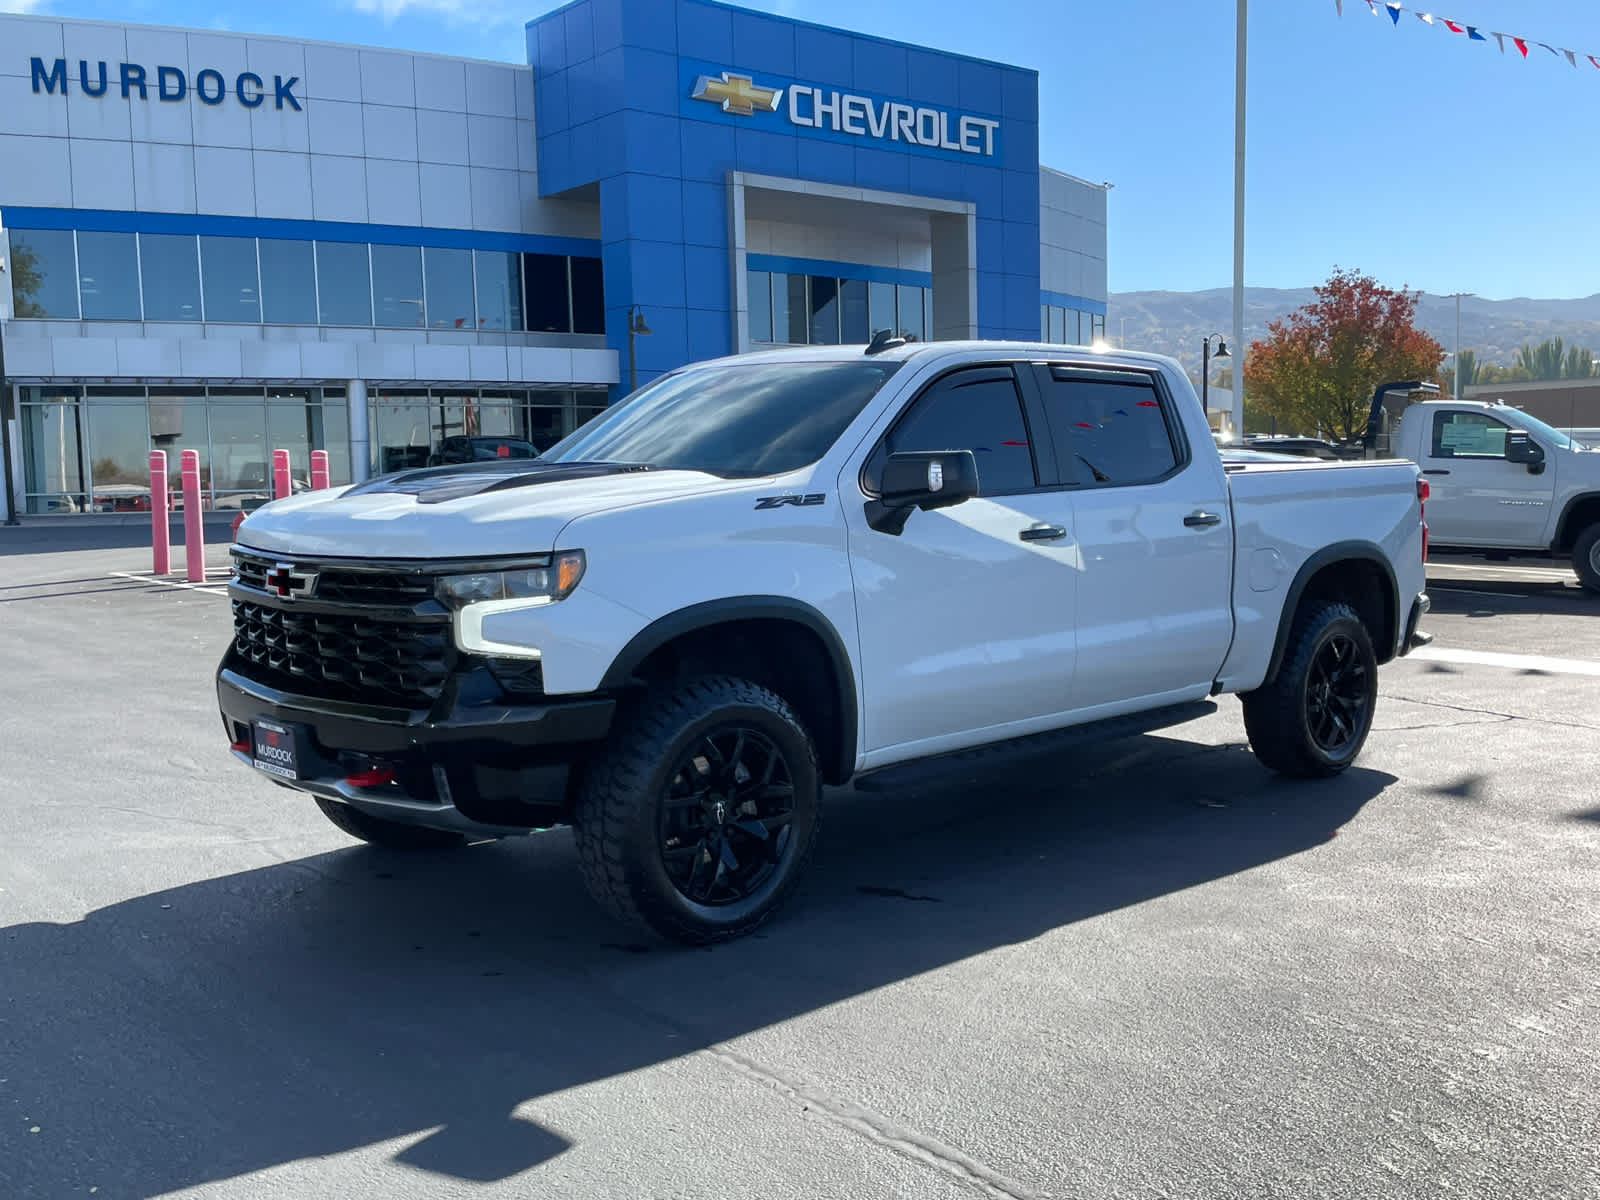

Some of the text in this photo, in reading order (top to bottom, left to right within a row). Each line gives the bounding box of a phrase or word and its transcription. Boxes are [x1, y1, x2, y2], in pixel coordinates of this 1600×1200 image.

[30, 56, 303, 111] MURDOCK
[788, 84, 1000, 156] CHEVROLET
[754, 493, 826, 510] ZR2
[257, 743, 292, 764] MURDOCK
